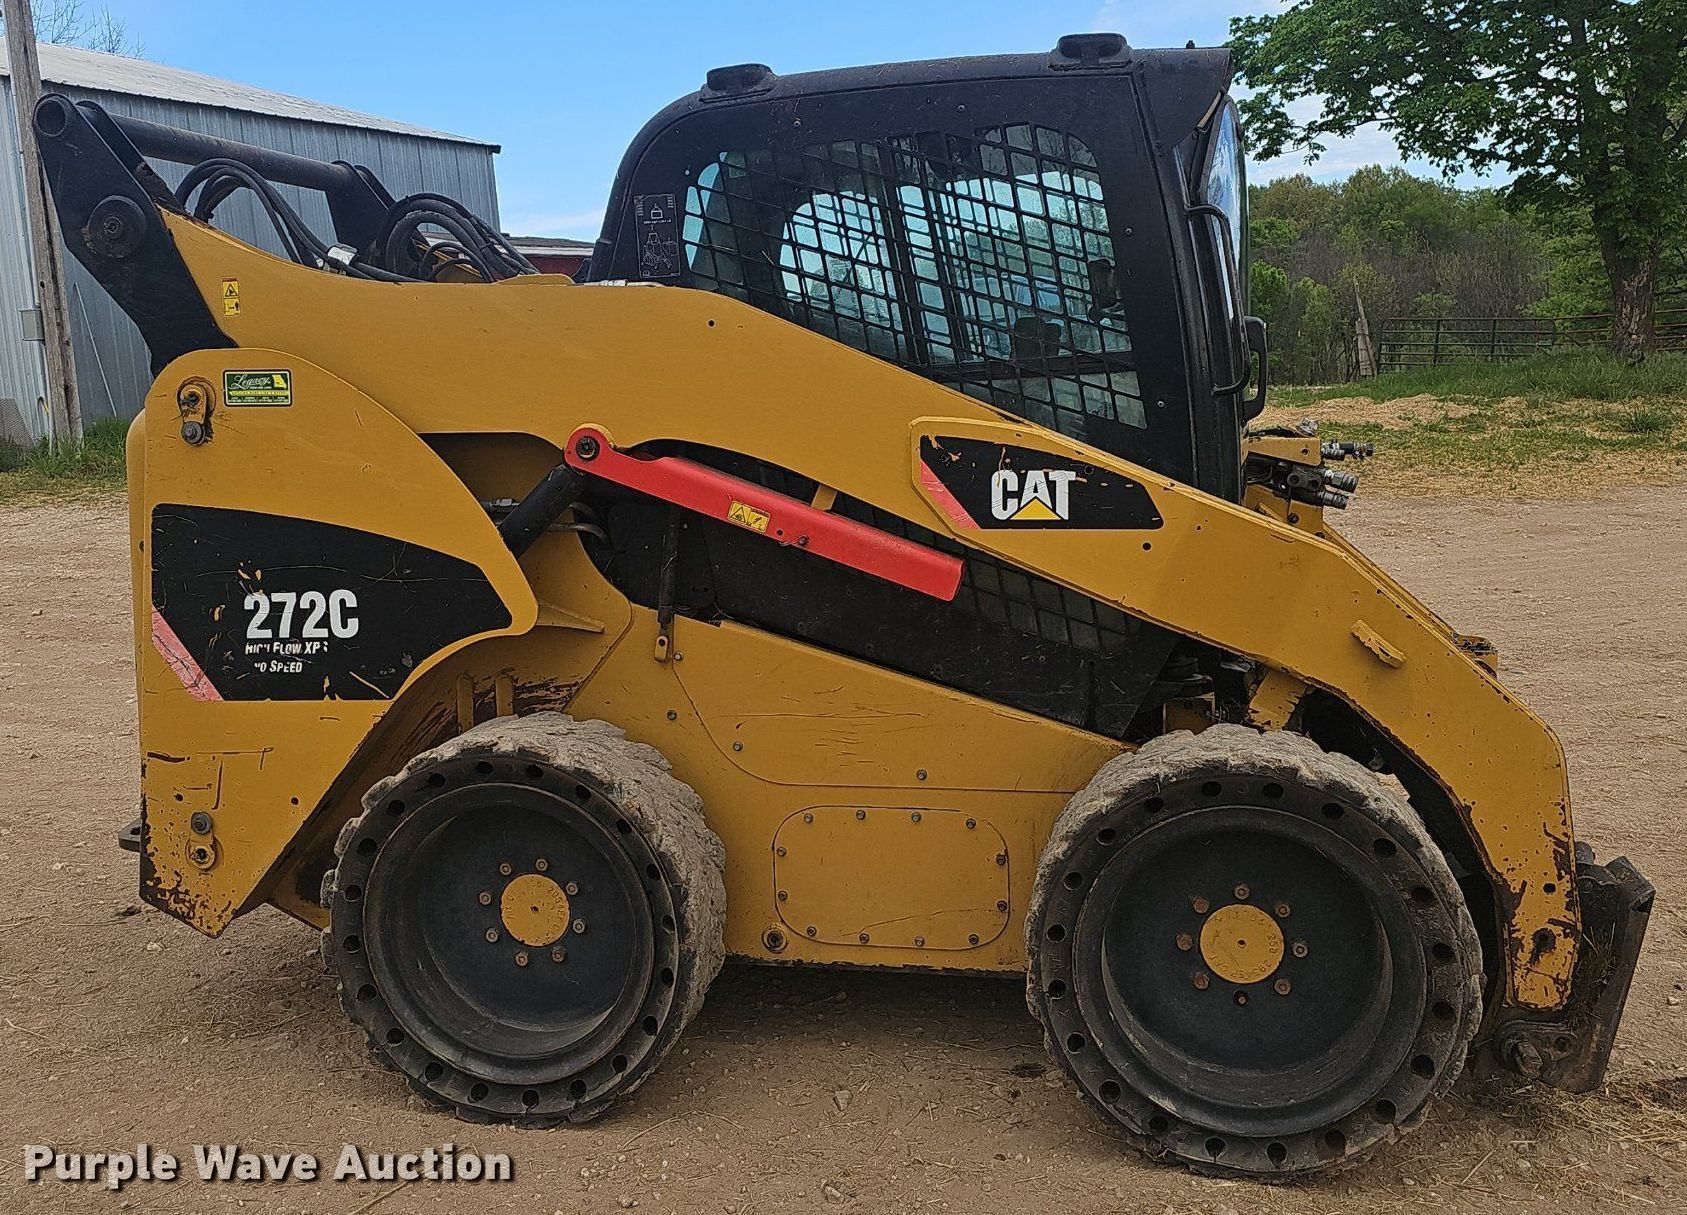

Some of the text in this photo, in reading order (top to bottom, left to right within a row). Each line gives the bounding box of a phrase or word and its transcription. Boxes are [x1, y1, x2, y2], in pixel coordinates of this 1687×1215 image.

[229, 374, 271, 389] Legacy
[989, 468, 1076, 520] CAT
[244, 589, 359, 638] 272C
[273, 642, 302, 655] FLOW
[269, 660, 303, 673] SPEED
